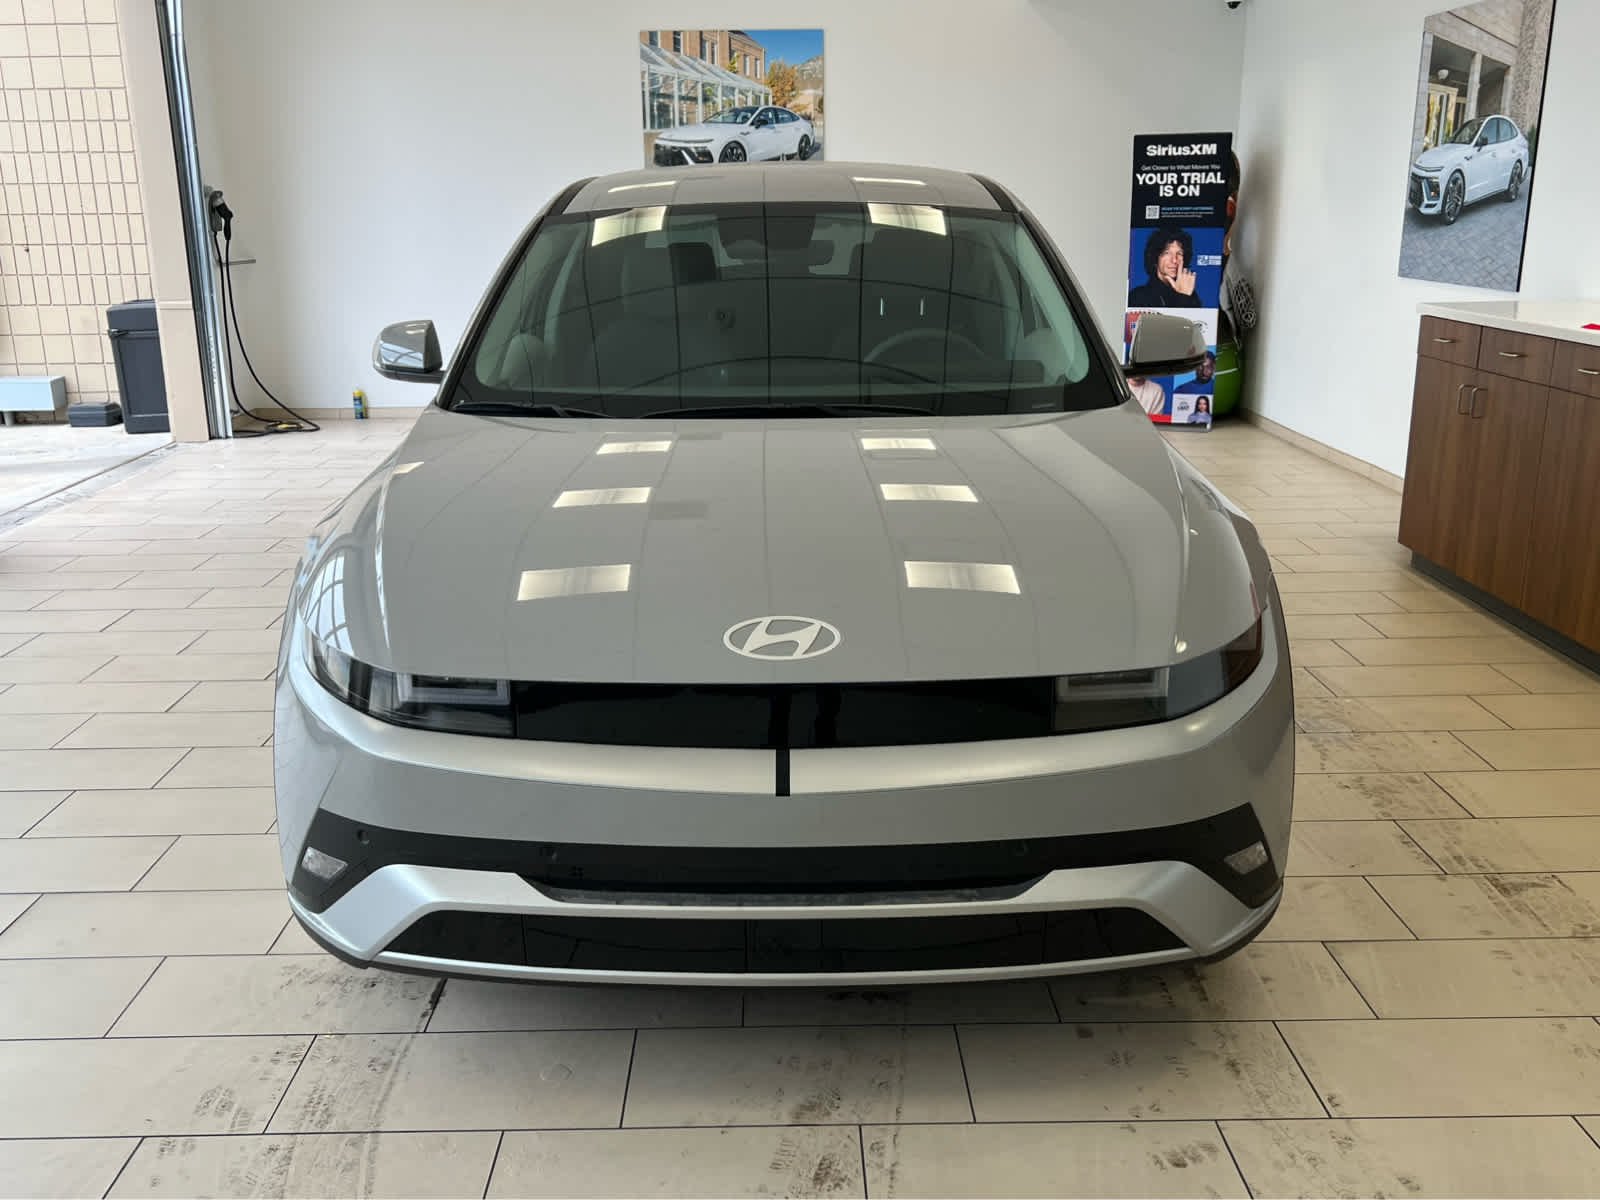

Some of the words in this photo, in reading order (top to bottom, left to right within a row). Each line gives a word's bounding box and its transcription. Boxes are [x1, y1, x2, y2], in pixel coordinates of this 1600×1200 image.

[1146, 143, 1217, 156] SiriusXM
[1136, 173, 1178, 185] YOUR
[1181, 172, 1226, 184] TRIAL
[1159, 185, 1174, 197] IS
[1177, 185, 1200, 197] ON
